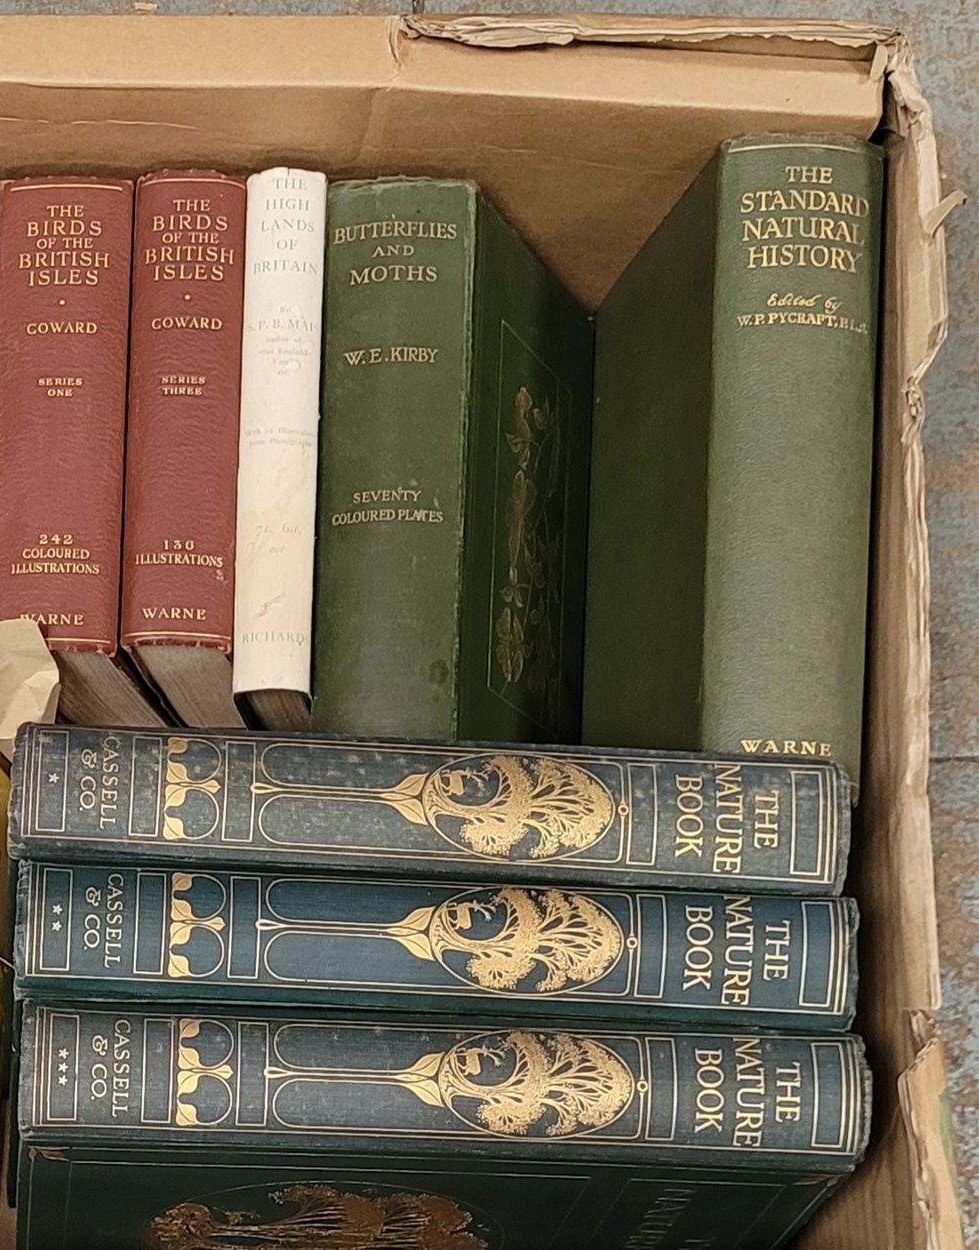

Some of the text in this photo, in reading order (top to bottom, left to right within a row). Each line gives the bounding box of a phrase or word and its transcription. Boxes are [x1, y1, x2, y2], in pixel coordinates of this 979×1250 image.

[786, 166, 833, 184] THE
[265, 198, 309, 212] HIGH
[740, 190, 869, 218] STANDARD
[26, 220, 102, 237] BIRDS
[261, 218, 314, 232] LANDS
[333, 221, 457, 245] BUTTERFLIES
[747, 245, 862, 273] HISTORY
[154, 264, 224, 281] ISLES
[350, 266, 437, 286] MOTHS
[767, 293, 821, 307] Edited
[26, 322, 98, 335] COWARD
[39, 377, 82, 387] SERIES
[48, 388, 72, 397] ONE
[353, 490, 421, 504] SEVENTY
[398, 510, 443, 523] PLATES
[39, 534, 73, 545] 242
[11, 562, 99, 575] ILLUSTRATIONS
[142, 606, 206, 621] WARNE
[740, 740, 832, 757] WARNE
[675, 774, 704, 858] BOOK
[712, 762, 745, 874] NATURE
[754, 790, 780, 849] THE
[104, 873, 124, 968] CASSELL
[112, 1019, 131, 1118] CASSELL
[91, 1064, 108, 1100] CO.
[694, 1048, 724, 1134] BOOK
[733, 1037, 765, 1147] NATURE
[775, 1062, 802, 1123] THE
